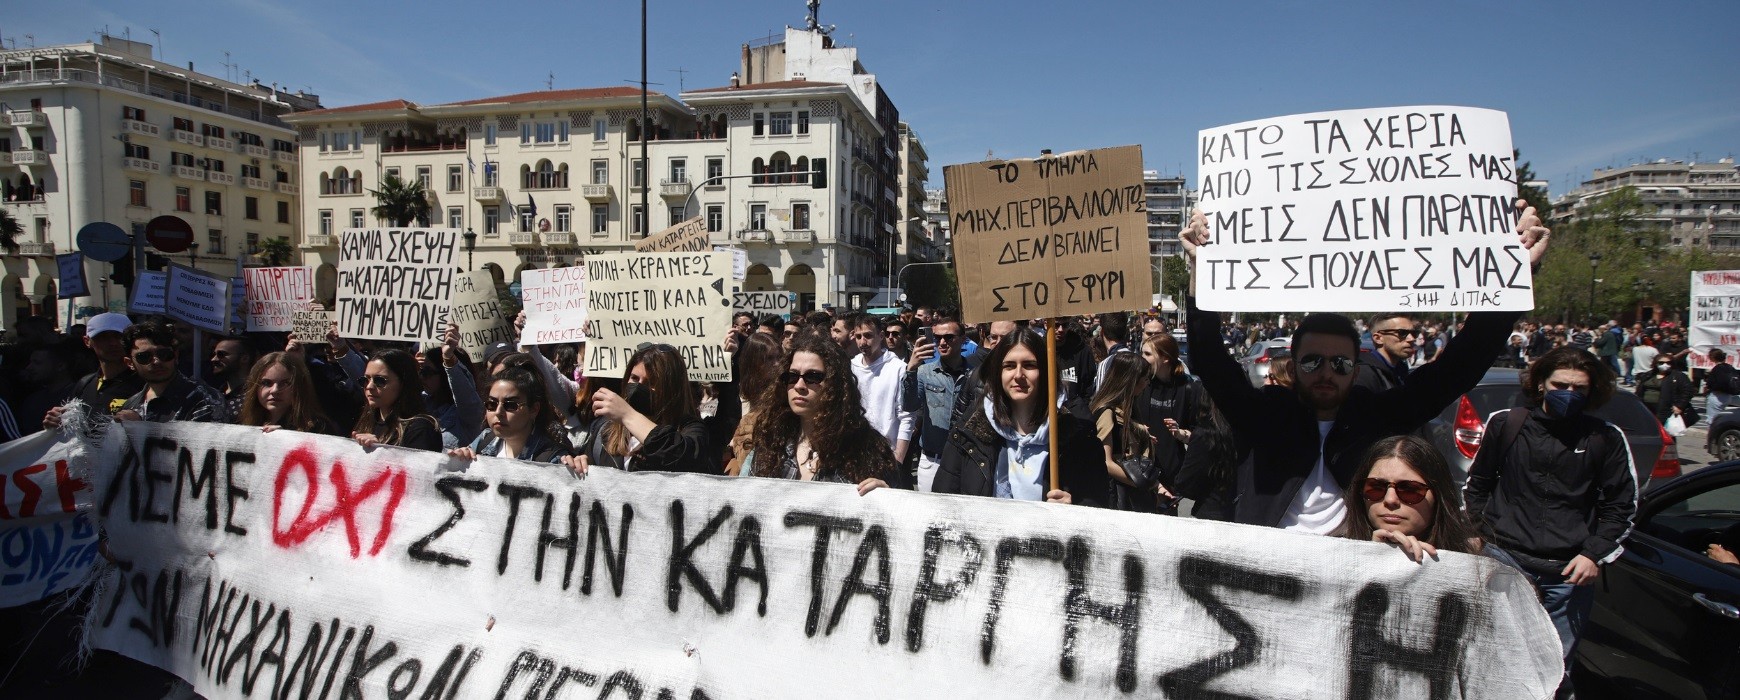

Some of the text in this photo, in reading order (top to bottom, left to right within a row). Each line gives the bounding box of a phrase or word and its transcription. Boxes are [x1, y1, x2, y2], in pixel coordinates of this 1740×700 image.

[1202, 112, 1466, 166] ΚΑΤΩ ΤΑ ΧΕΡΙΑ
[988, 153, 1099, 184] ΤΟ ΤΜΗΜΑ
[1200, 153, 1518, 202] ΑΠΟ ΤΙΣ ΣΧΟΛΕΣ ΜΑΣ
[1323, 196, 1390, 242] ΔΕΝ
[1403, 193, 1522, 240] ΠΑΡΑΤΑΜ
[341, 230, 456, 264] ΚΑΜΙΑ ΣΚΕΨΗ
[998, 226, 1119, 265] ΔΕΝ ΒΓΑΙΝΕΙ
[338, 265, 453, 300] ΓΙΑ ΚΑΤΑΡΓΗΣΗ
[538, 266, 585, 283] ΤΕΛΟΣ
[1206, 245, 1531, 291] ΤΙΣ ΣΠΟΥΔΕΣ ΜΑΣ
[523, 282, 586, 302] ΣΤΗΝ ΠΑΙ
[536, 302, 561, 312] ΤΩΝ
[589, 290, 639, 312] ΑΚΟΥΣΤΕ
[644, 290, 656, 311] ΤΟ
[664, 287, 707, 308] ΚΑΛΑ
[732, 293, 788, 310] ΣΧΕΔΙΟ
[992, 270, 1124, 313] ΣΤΟ ΣΦΥΡΙ
[315, 312, 328, 320] ΓΙΑ
[339, 297, 437, 340] ΤΜΗΜΑΤΩΝ
[588, 316, 705, 340] ΟΙ ΜΗΧΑΝΙΚΟΙ
[589, 346, 617, 371] ΔΕΝ
[101, 436, 256, 537] ΛΕΜΕ
[271, 443, 407, 560] ΟΧΙ
[408, 474, 634, 597] ΣΤΗΝ
[664, 498, 1472, 700] ΚΑΤΑΡΓΗΣΗ
